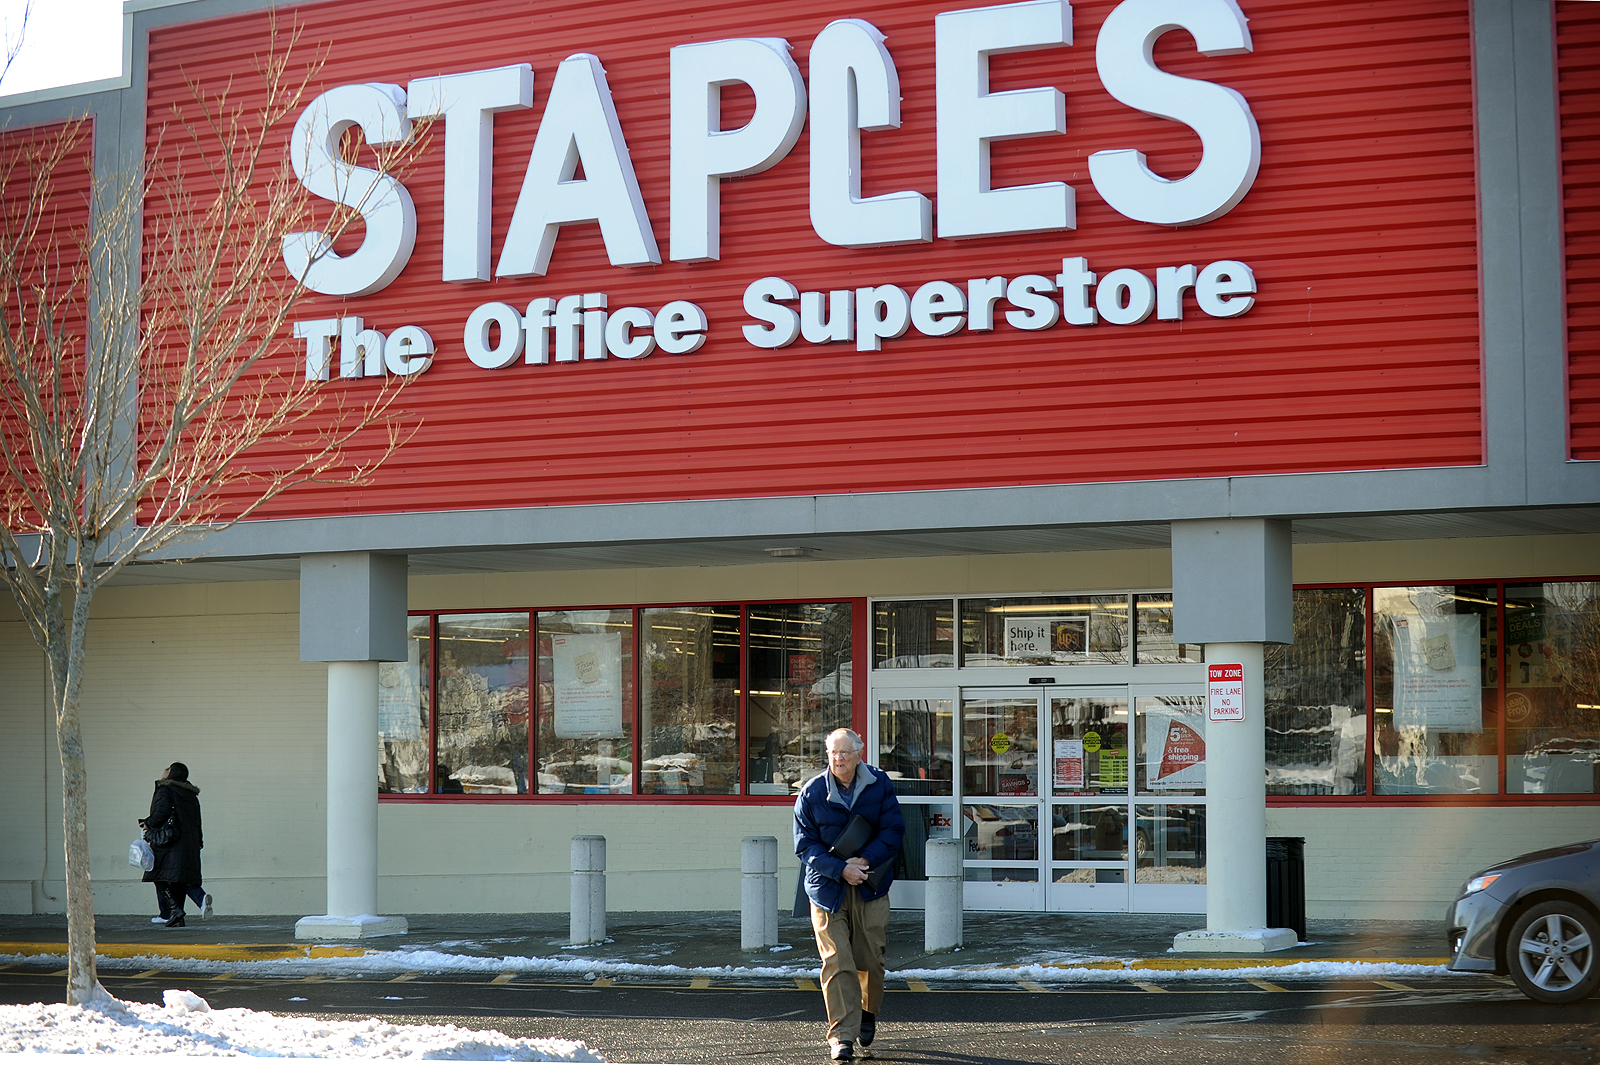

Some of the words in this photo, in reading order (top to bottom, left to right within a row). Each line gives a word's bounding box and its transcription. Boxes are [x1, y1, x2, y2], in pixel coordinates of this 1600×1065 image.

[280, 0, 1262, 297] STAPLES
[293, 315, 434, 382] The
[463, 292, 708, 369] Office
[741, 256, 1257, 352] Superstore
[1510, 619, 1540, 633] DEALS
[1010, 626, 1034, 641] Ship
[1037, 626, 1045, 638] it
[1010, 640, 1038, 652] here.
[1209, 669, 1223, 678] TOW
[1224, 669, 1242, 678] ZONE
[1210, 688, 1224, 696] FIRE
[1225, 687, 1242, 696] LANE
[1221, 698, 1231, 706] NO
[1506, 696, 1524, 708] Leap
[1213, 707, 1240, 715] PARKING
[1508, 704, 1528, 717] Frog
[1168, 753, 1199, 762] shipping
[1001, 779, 1026, 788] SAVINGS
[929, 814, 952, 827] dEx
